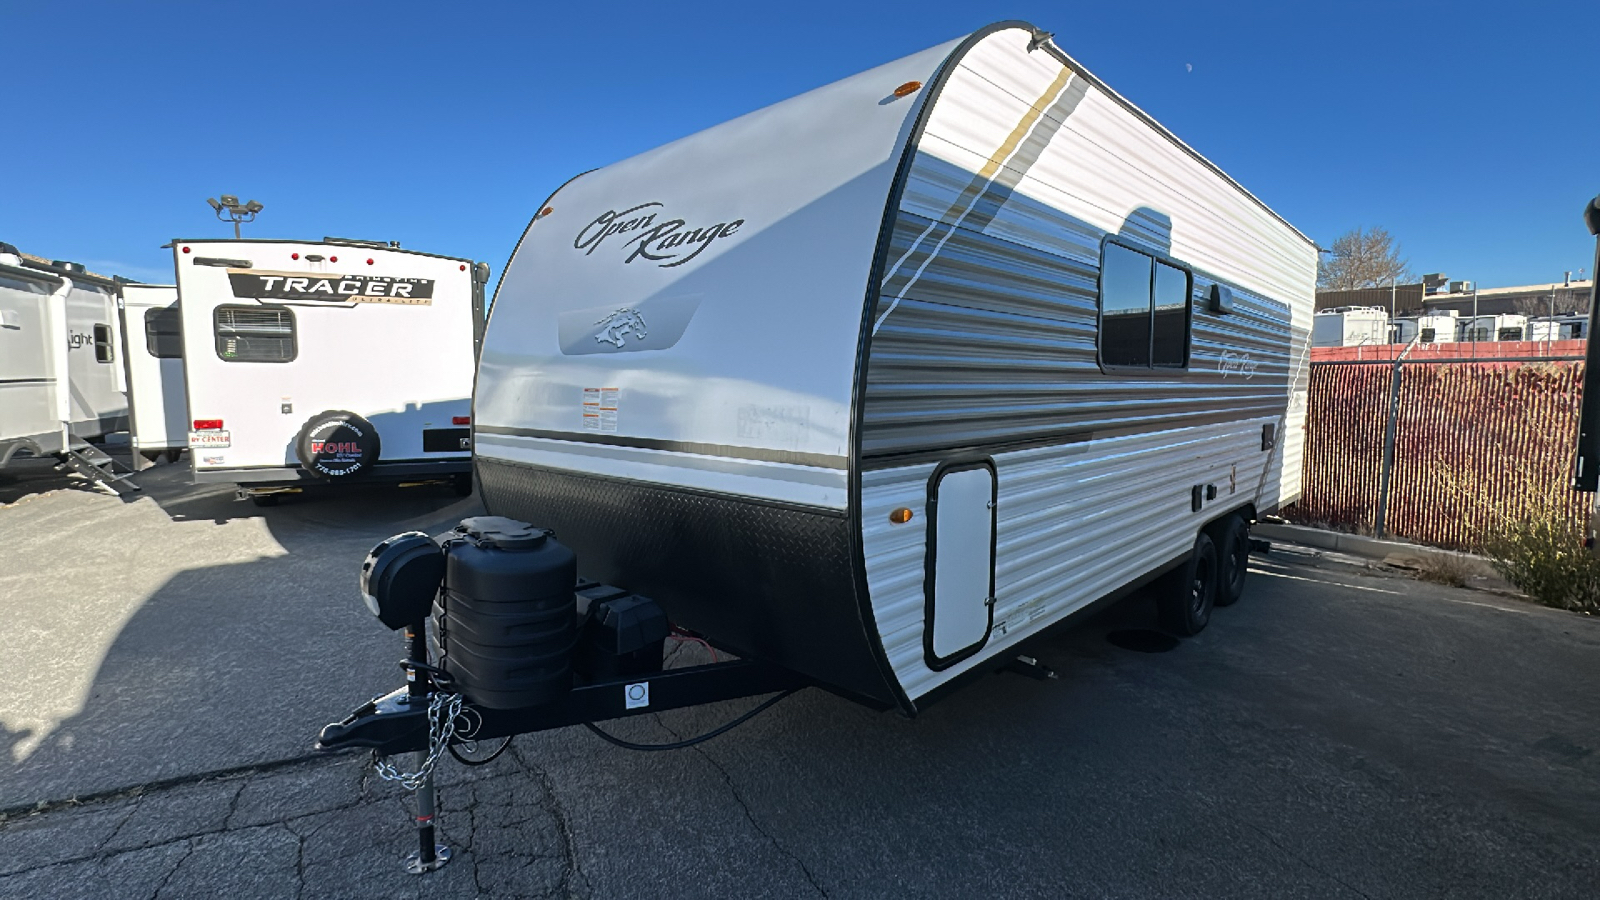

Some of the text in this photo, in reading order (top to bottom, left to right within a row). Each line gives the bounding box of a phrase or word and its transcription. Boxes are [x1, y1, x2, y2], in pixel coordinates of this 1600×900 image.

[574, 202, 664, 255] Open
[621, 219, 745, 268] Range
[259, 276, 413, 298] TRACER
[68, 329, 93, 352] ight
[311, 442, 362, 453] HOHL
